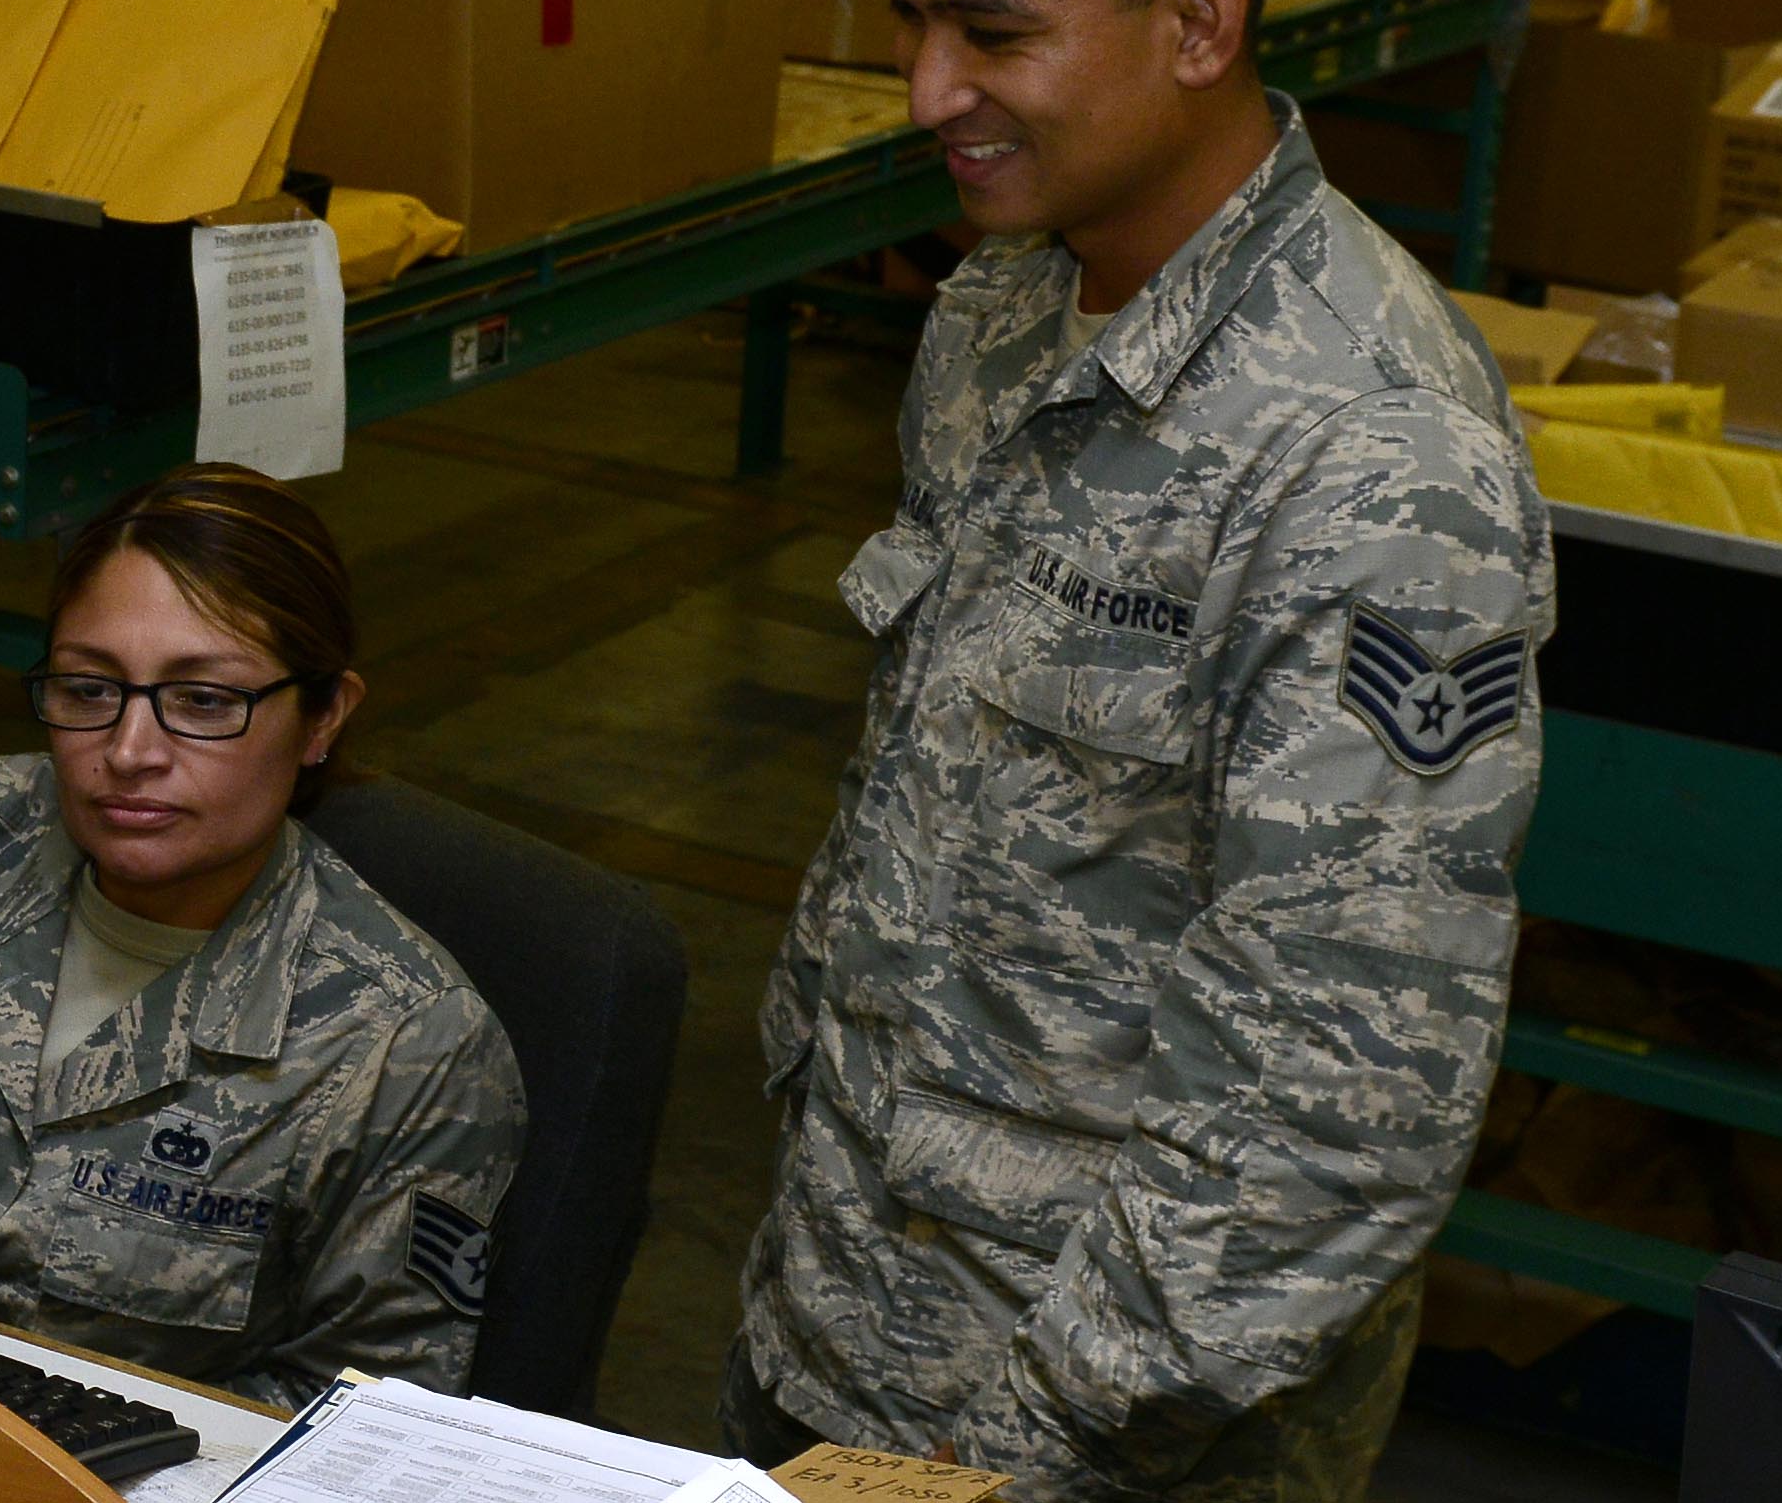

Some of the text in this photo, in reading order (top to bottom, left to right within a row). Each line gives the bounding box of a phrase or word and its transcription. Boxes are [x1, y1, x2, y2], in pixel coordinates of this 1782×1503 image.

[1028, 548, 1190, 639] U.S. AIR FORCE
[72, 1157, 275, 1231] U.S. AIR FORCE
